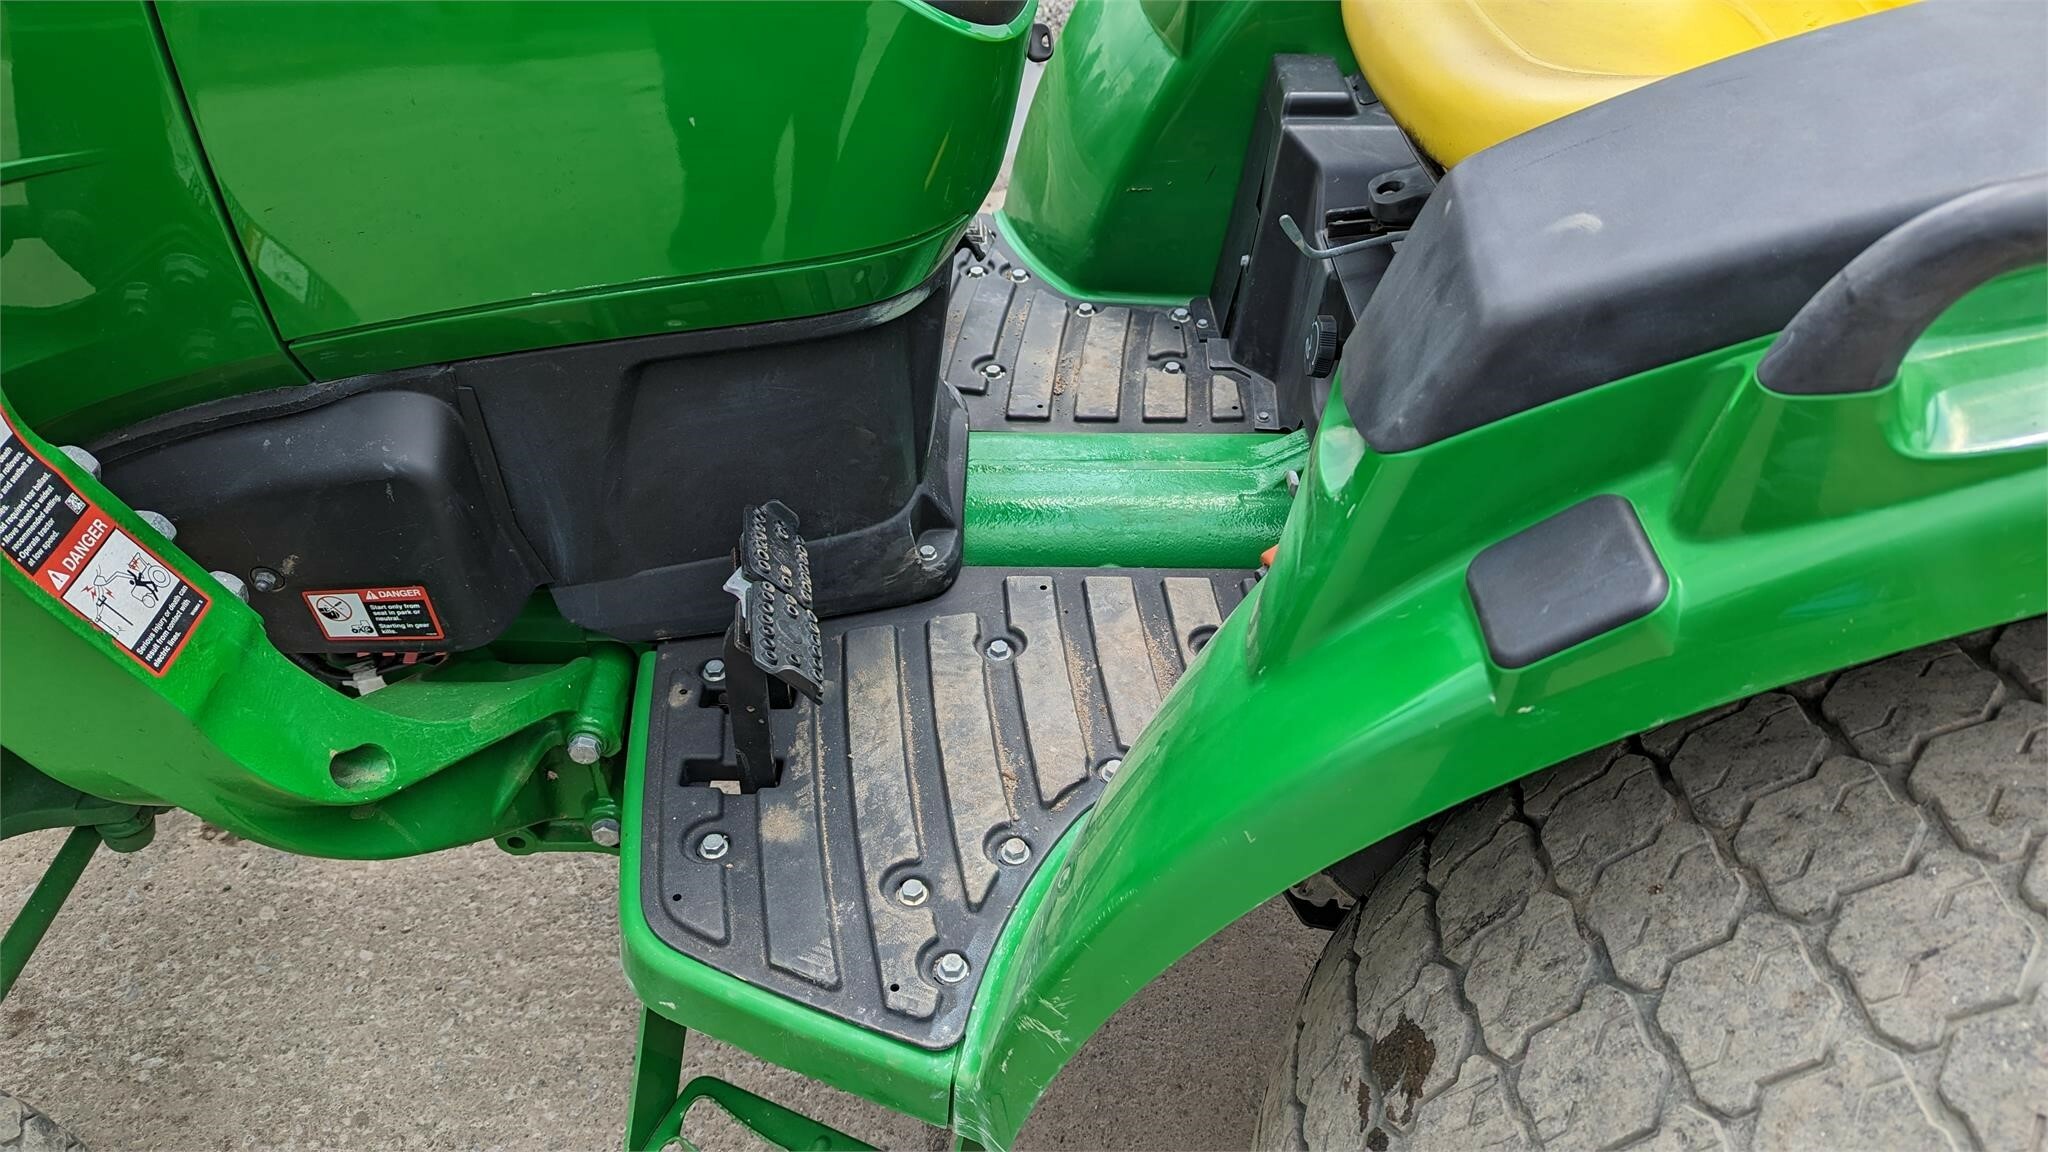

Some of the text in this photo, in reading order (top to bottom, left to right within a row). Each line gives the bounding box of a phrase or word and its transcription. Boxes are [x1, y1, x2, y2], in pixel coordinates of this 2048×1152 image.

[2, 451, 24, 475] rollovers.
[2, 455, 35, 495] and seatbelt at
[2, 484, 55, 545] Move wheels to widest
[5, 499, 28, 526] required
[24, 489, 37, 503] rear
[32, 470, 52, 492] ballast.
[11, 493, 62, 553] recommended setting.
[18, 517, 56, 560] Operate tractor
[27, 529, 60, 567] at low speed.
[63, 519, 108, 571] DANGER
[378, 590, 421, 598] DANGER
[387, 603, 403, 611] only
[136, 584, 189, 656] Serious injury or death can
[144, 598, 191, 662] result from contact with
[152, 630, 182, 668] electric lines.
